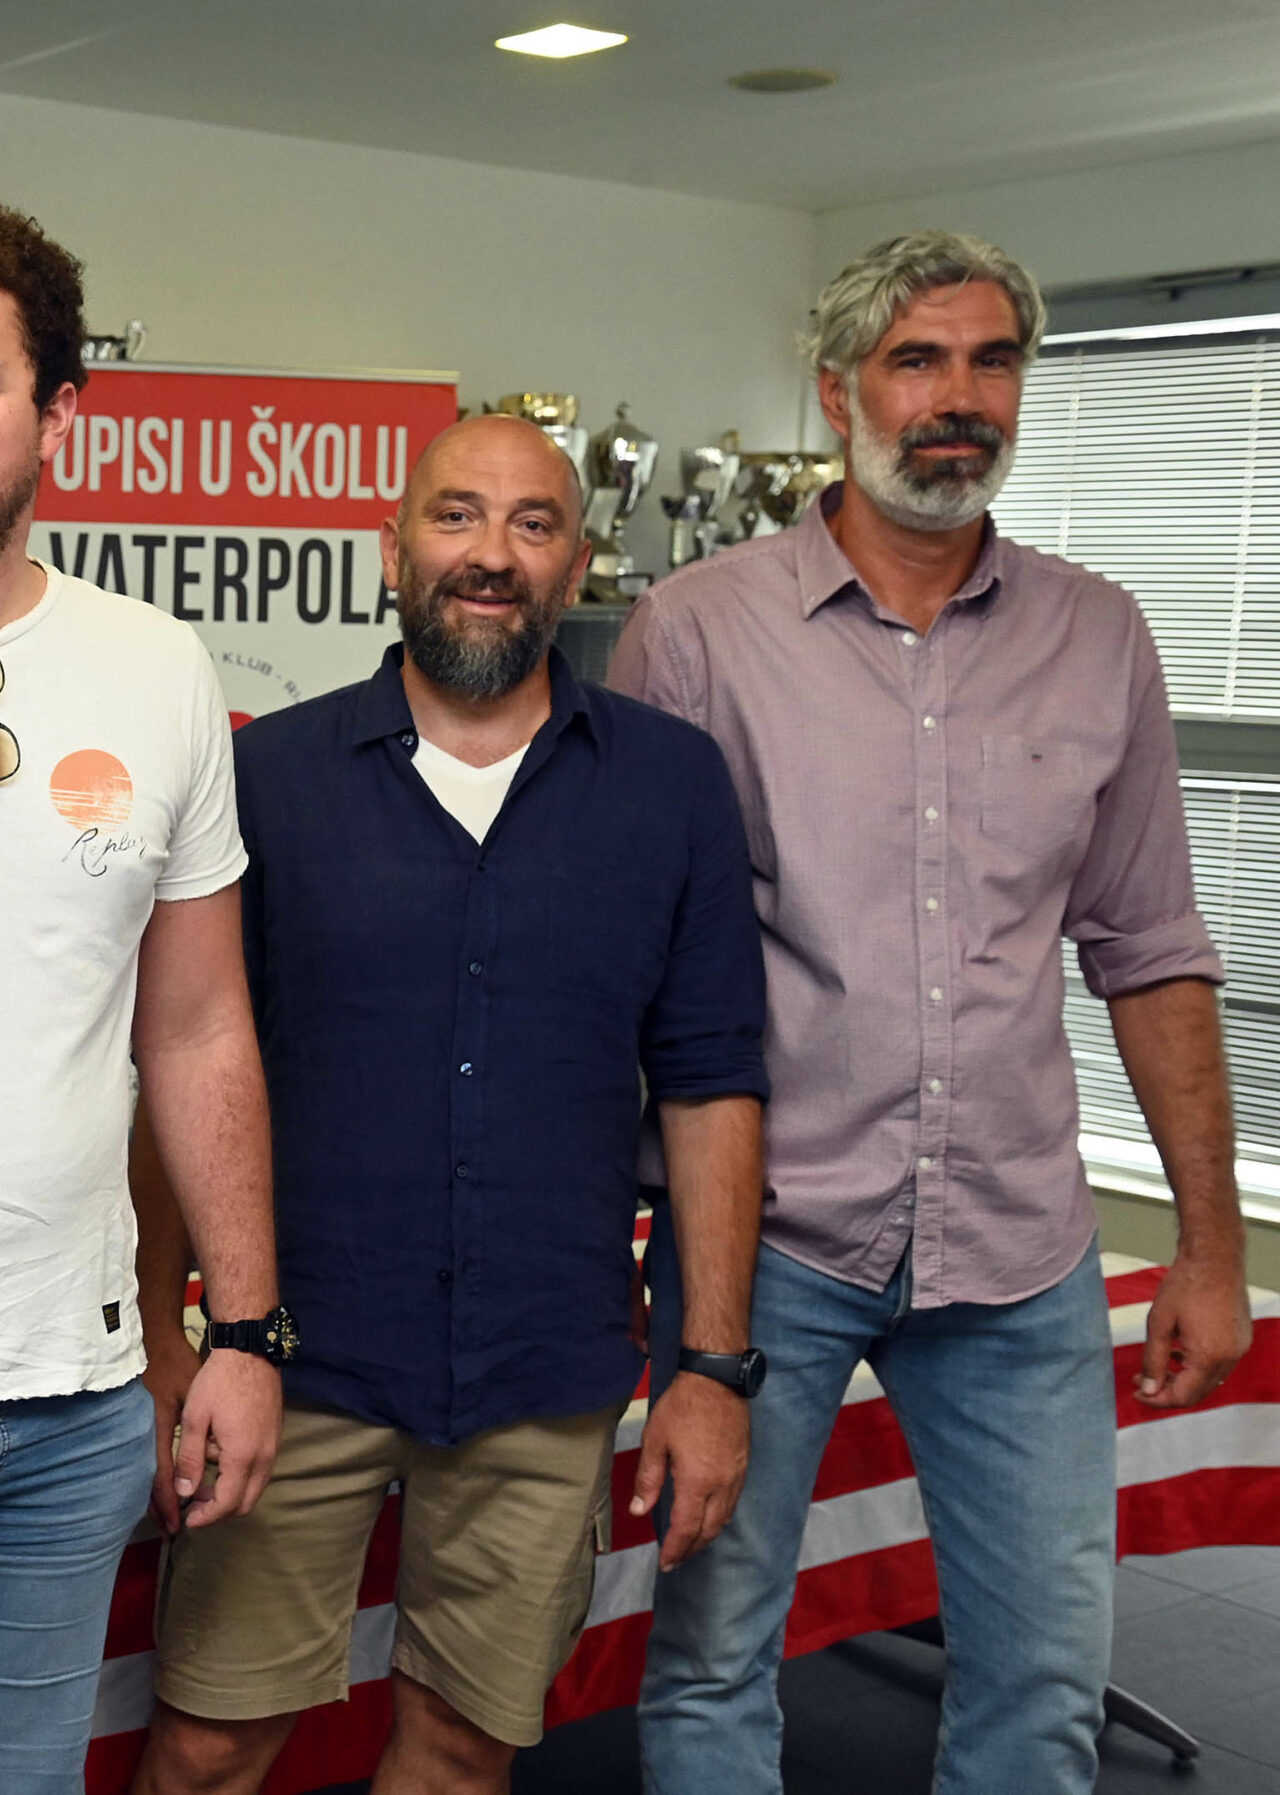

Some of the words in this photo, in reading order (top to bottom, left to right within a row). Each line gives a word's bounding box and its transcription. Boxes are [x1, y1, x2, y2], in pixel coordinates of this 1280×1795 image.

[52, 414, 185, 494] UPISI
[198, 418, 233, 497] U
[246, 404, 408, 502] ŠKOLU
